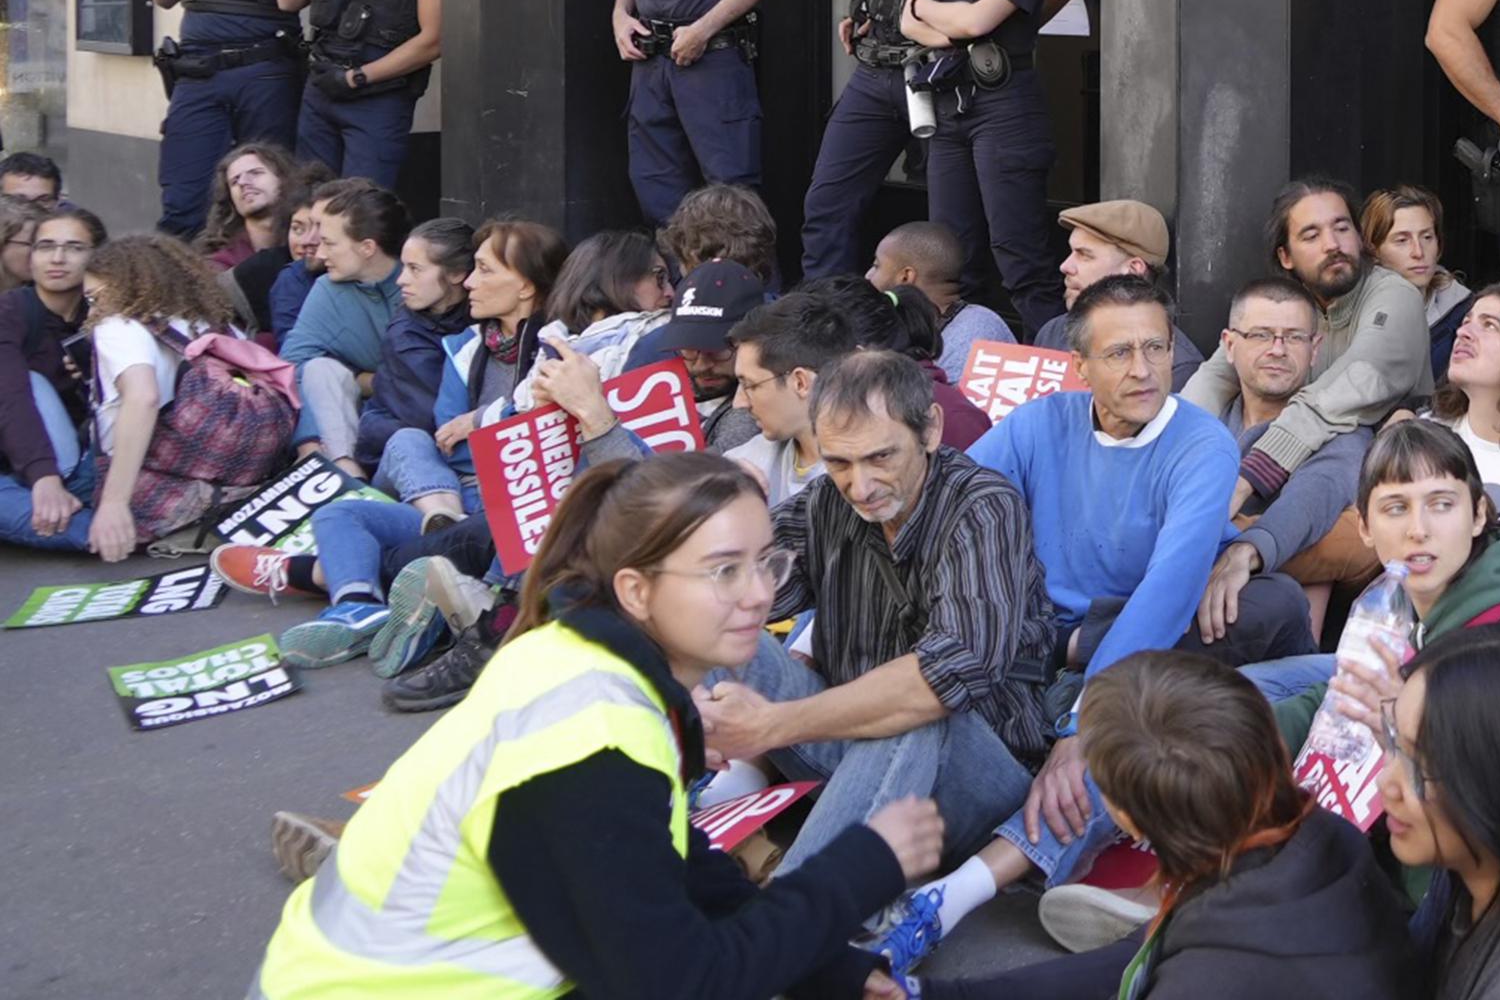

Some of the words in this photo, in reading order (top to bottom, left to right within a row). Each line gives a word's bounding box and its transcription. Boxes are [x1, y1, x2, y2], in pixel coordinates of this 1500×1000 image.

[988, 356, 1039, 425] TAL
[1031, 358, 1068, 400] SIE
[217, 457, 324, 535] MOZAMBIQUE
[229, 471, 343, 546] LNG
[140, 566, 207, 614] LNG
[121, 643, 268, 681] CHAOS
[122, 655, 279, 698] TOTAL
[134, 666, 290, 717] LNG
[140, 682, 293, 727] MOZAMBIQUE
